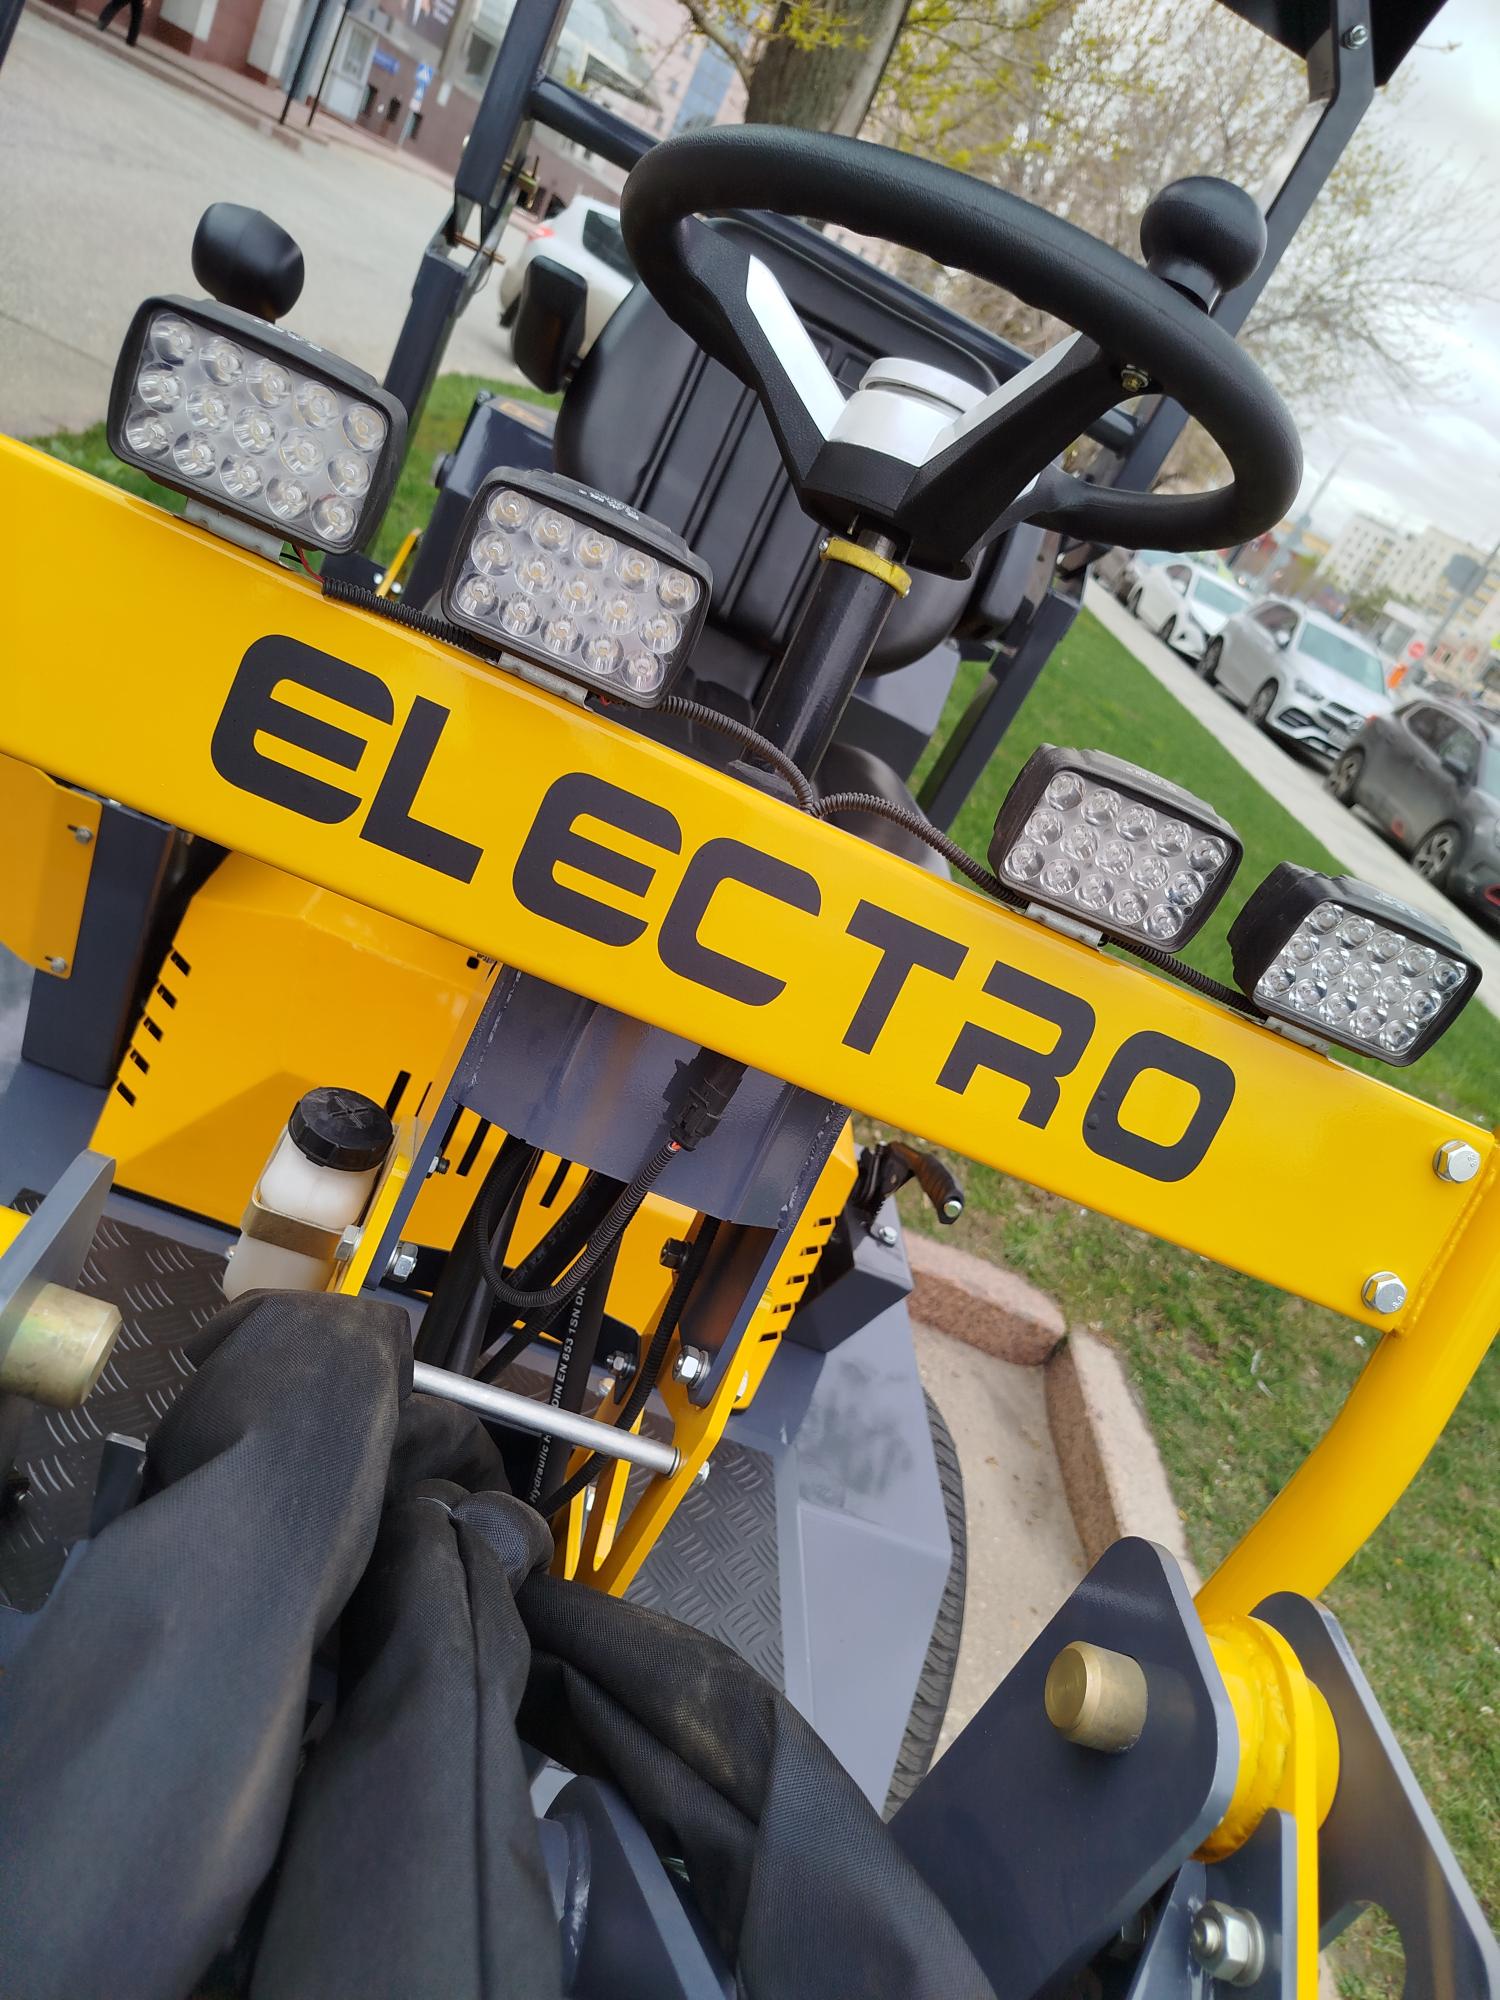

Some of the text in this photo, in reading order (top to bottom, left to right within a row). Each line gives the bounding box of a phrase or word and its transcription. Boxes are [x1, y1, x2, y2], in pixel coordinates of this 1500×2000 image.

[211, 635, 1235, 1183] ELECTRO
[568, 1308, 581, 1333] 1SN
[562, 1339, 574, 1361] 853
[556, 1363, 568, 1383] EN
[551, 1384, 563, 1409] DIN
[529, 1444, 549, 1503] Hydraulic
